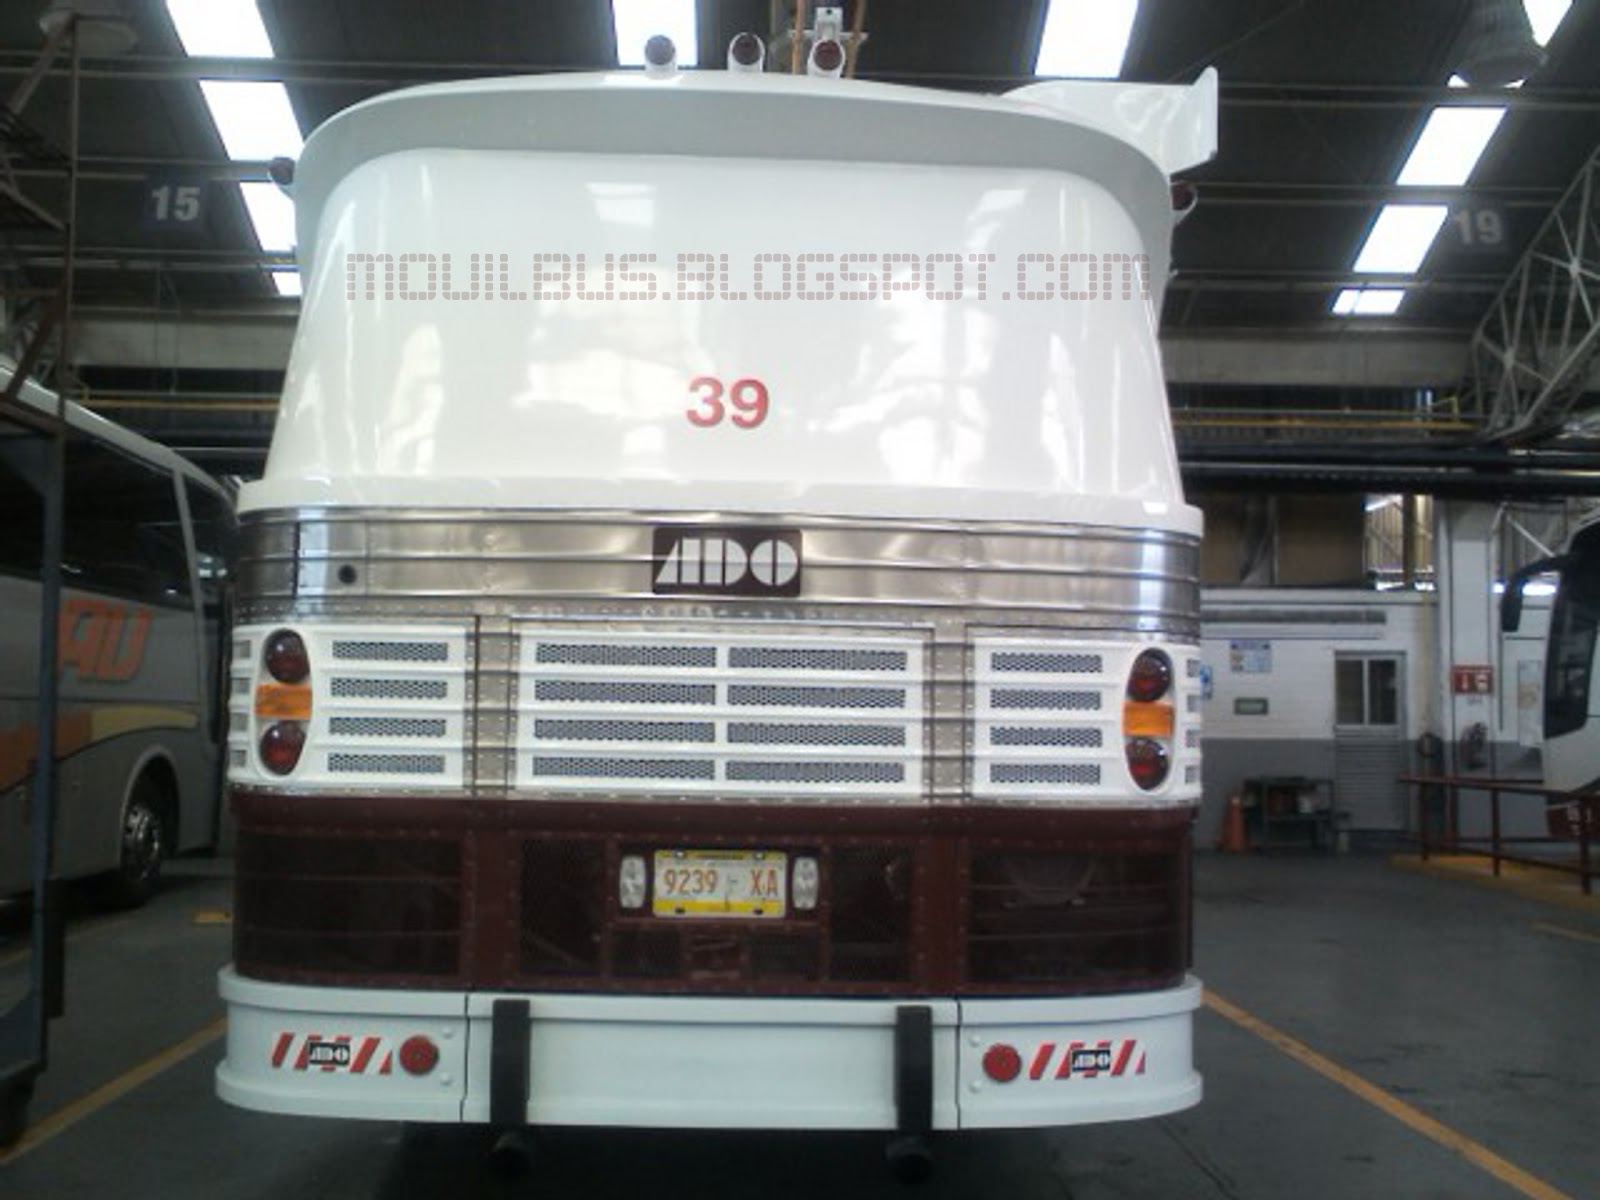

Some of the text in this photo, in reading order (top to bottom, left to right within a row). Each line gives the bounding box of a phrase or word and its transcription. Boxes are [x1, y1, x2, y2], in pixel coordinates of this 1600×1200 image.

[152, 186, 200, 221] 15
[1454, 209, 1502, 244] 19
[686, 376, 770, 429] 39
[654, 536, 799, 587] ADO
[663, 868, 719, 895] 9239
